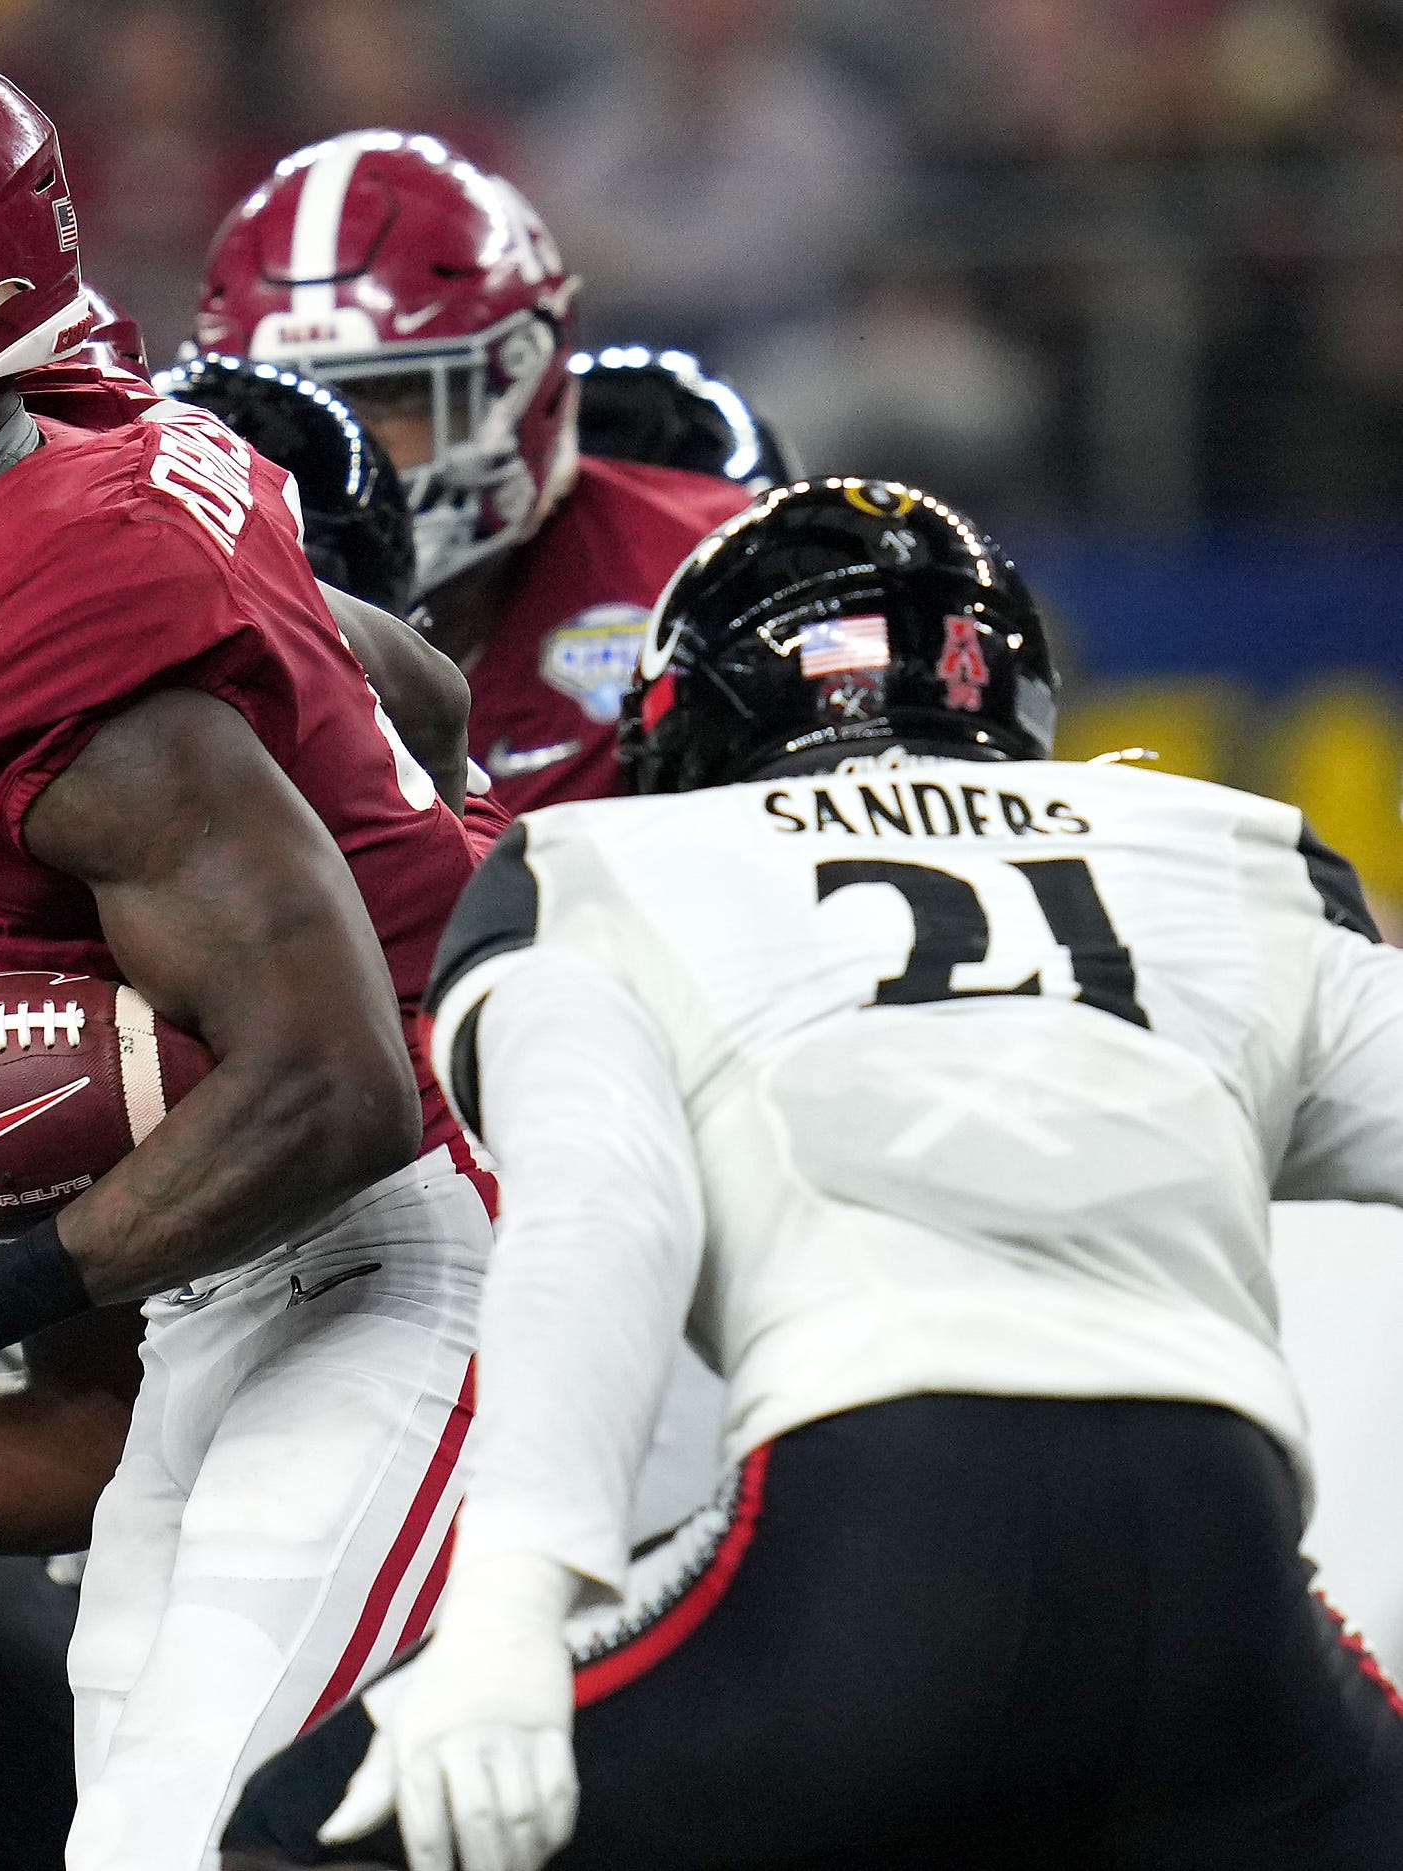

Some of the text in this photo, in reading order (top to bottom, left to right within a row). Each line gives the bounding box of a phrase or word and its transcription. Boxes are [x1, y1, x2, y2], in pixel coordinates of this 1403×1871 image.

[763, 781, 1092, 837] SANDERS
[815, 857, 1153, 1032] 21
[19, 1173, 94, 1204] ELITE
